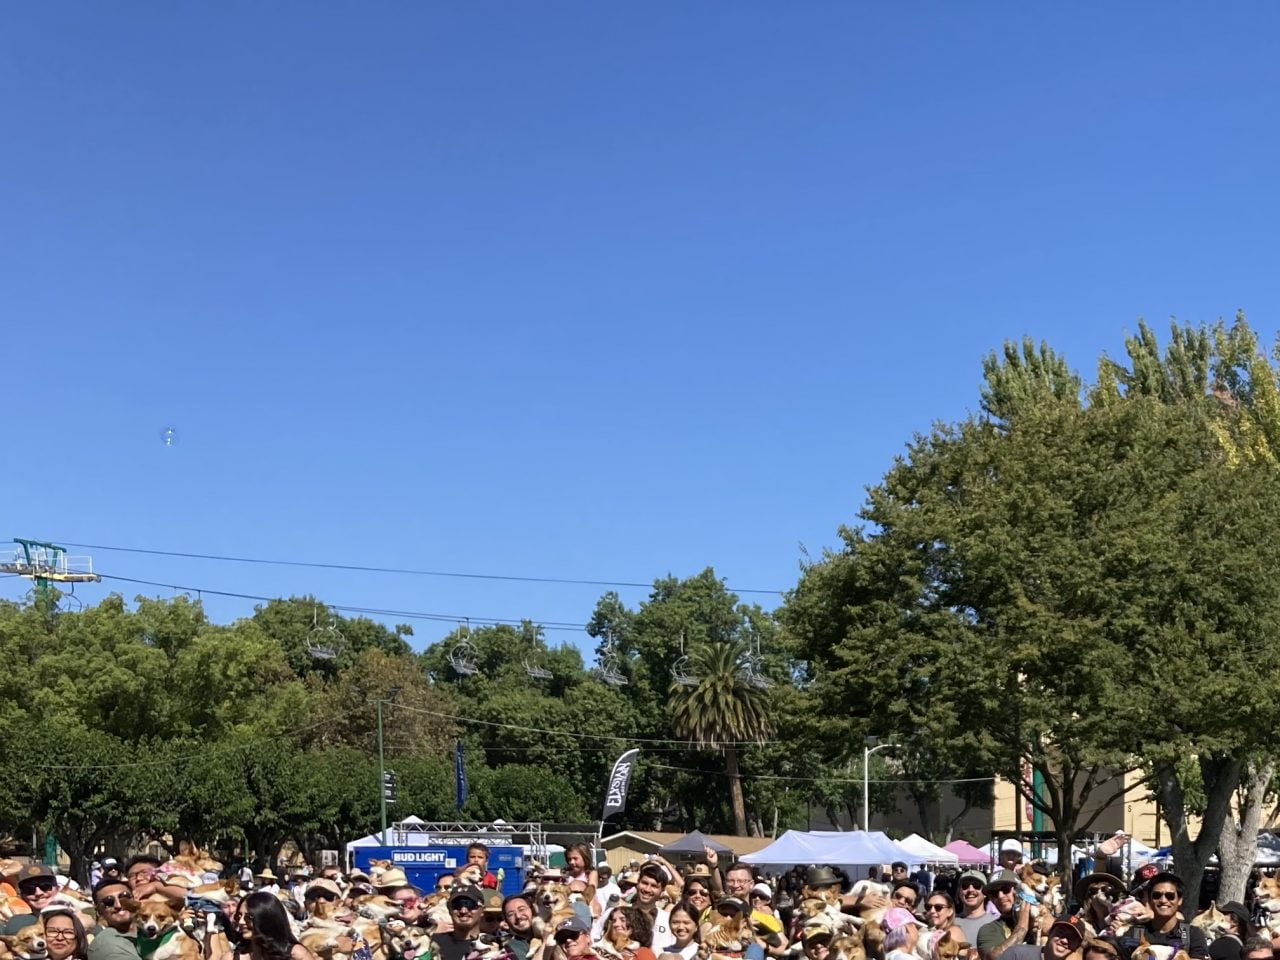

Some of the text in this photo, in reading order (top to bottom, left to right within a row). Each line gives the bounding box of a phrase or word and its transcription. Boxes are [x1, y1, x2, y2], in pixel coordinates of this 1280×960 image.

[607, 762, 631, 806] ELYSIAN
[393, 853, 445, 861] BUD LIGHT
